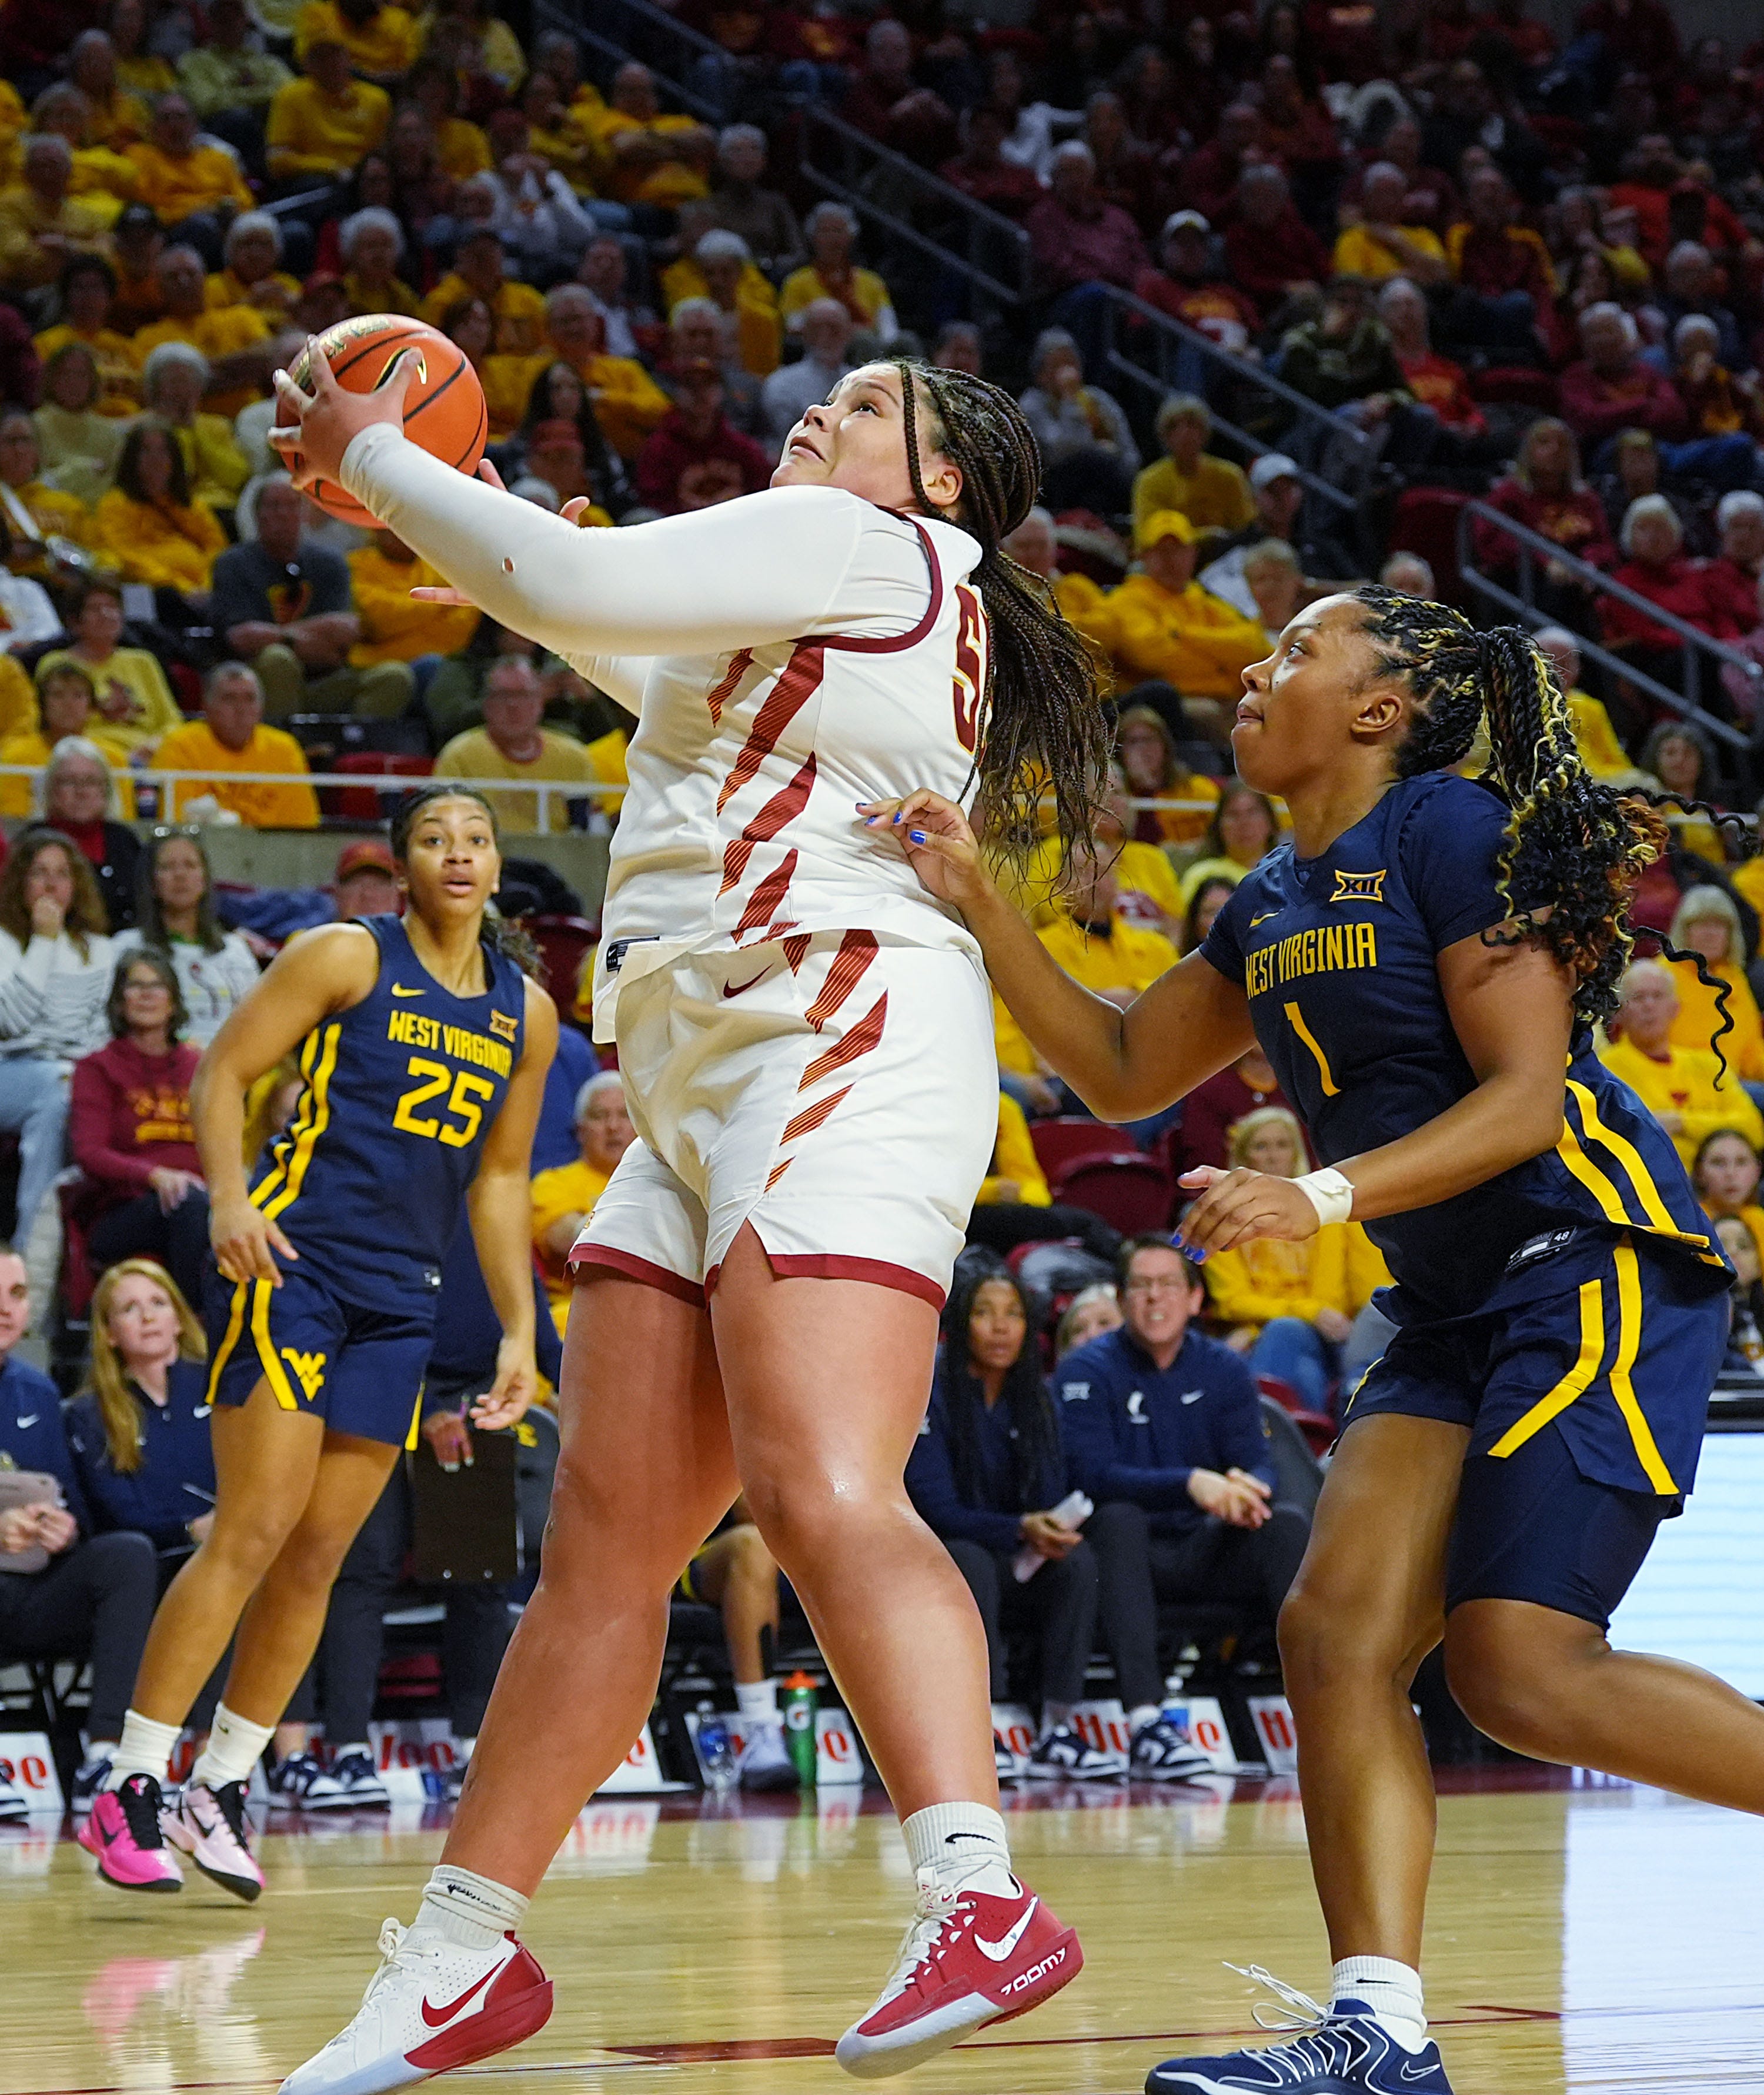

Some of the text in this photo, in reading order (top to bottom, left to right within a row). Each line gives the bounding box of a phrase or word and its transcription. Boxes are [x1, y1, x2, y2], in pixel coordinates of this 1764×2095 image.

[952, 583, 994, 768] 5
[1245, 922, 1377, 1000] WEST VIRGINIA
[387, 1010, 442, 1051] WEST
[442, 1024, 513, 1080] VIRGINIA
[1283, 1001, 1342, 1097] 1
[392, 1056, 495, 1148] 25
[1553, 1231, 1570, 1241] 48
